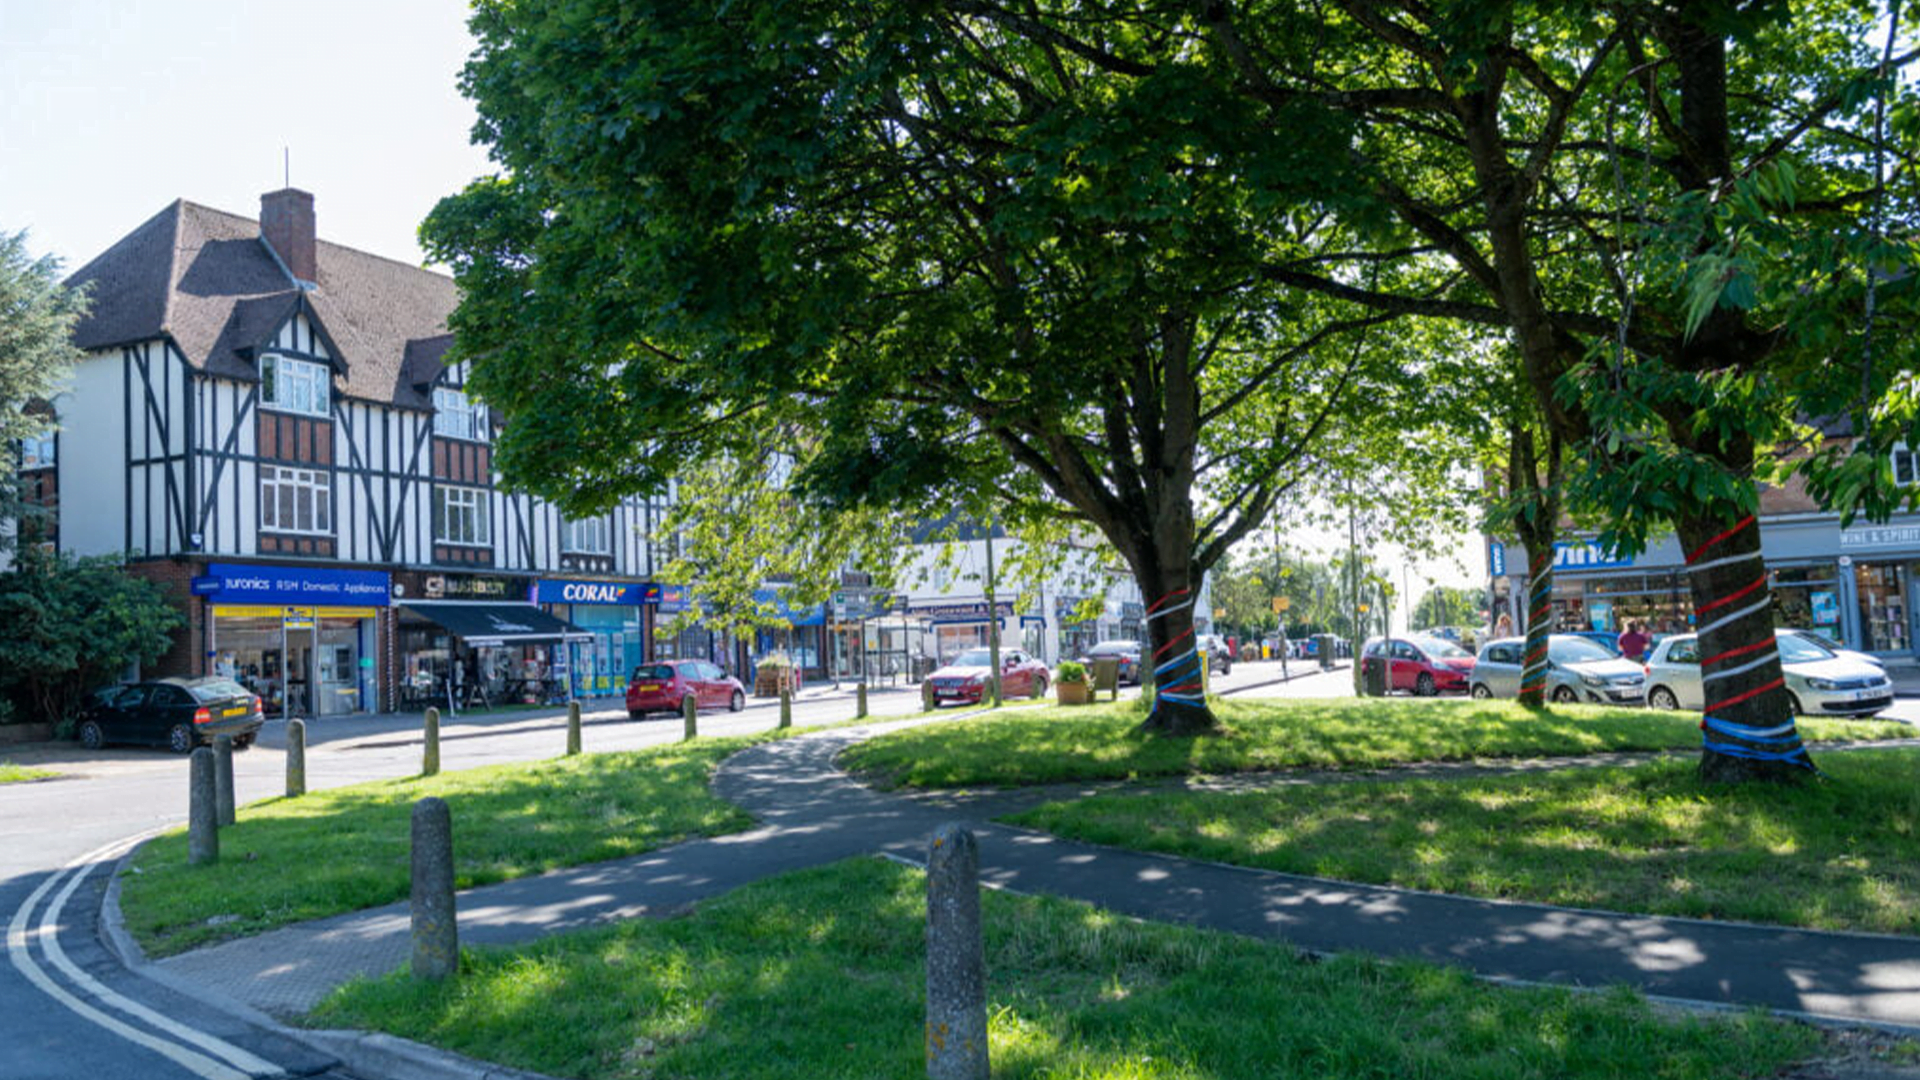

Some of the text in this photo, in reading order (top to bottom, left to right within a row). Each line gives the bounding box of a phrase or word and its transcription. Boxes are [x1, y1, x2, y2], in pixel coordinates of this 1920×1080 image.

[1840, 531, 1866, 545] WINE
[1871, 530, 1879, 543] &
[303, 580, 340, 593] Domestic
[344, 582, 386, 595] Appliances
[563, 584, 618, 602] CORAL
